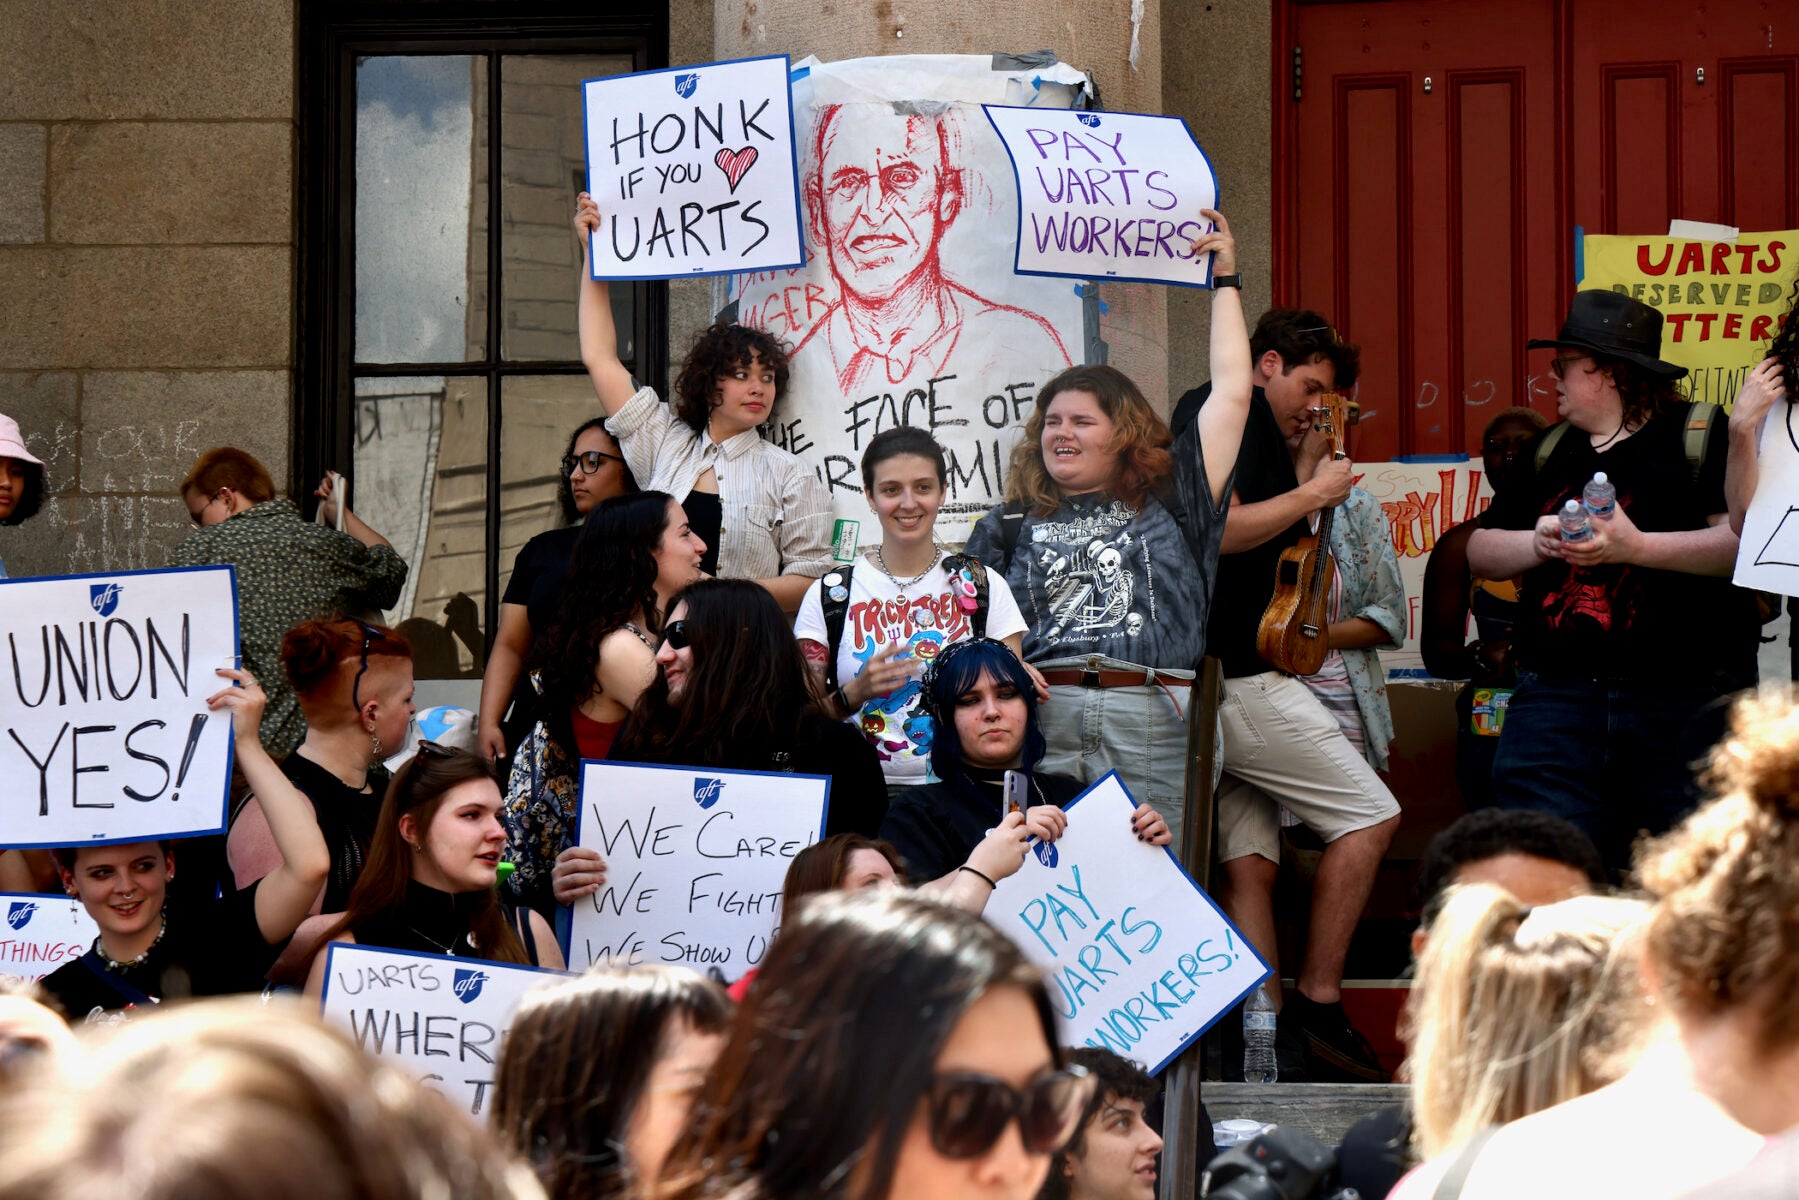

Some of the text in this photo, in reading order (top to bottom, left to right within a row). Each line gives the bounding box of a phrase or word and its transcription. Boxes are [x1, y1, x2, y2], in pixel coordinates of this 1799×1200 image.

[610, 98, 775, 165] HONK
[1026, 128, 1127, 166] PAY
[620, 162, 701, 200] IF YOU
[1036, 166, 1178, 211] UARTS
[611, 200, 770, 262] UARTS
[1636, 240, 1787, 277] UARTS
[1666, 312, 1789, 343] TTER
[844, 375, 970, 451] FACE
[982, 381, 1036, 430] OF
[8, 613, 190, 708] UNION
[7, 713, 209, 816] YES!
[593, 803, 814, 859] WE CARE!
[591, 871, 785, 917] WE FIGHT
[1019, 864, 1100, 957] PAY
[0, 939, 83, 964] THINGS
[660, 931, 732, 965] SHOW
[338, 963, 441, 995] UARTS
[1084, 928, 1240, 1055] WORKERS!
[350, 1008, 510, 1065] WHER
